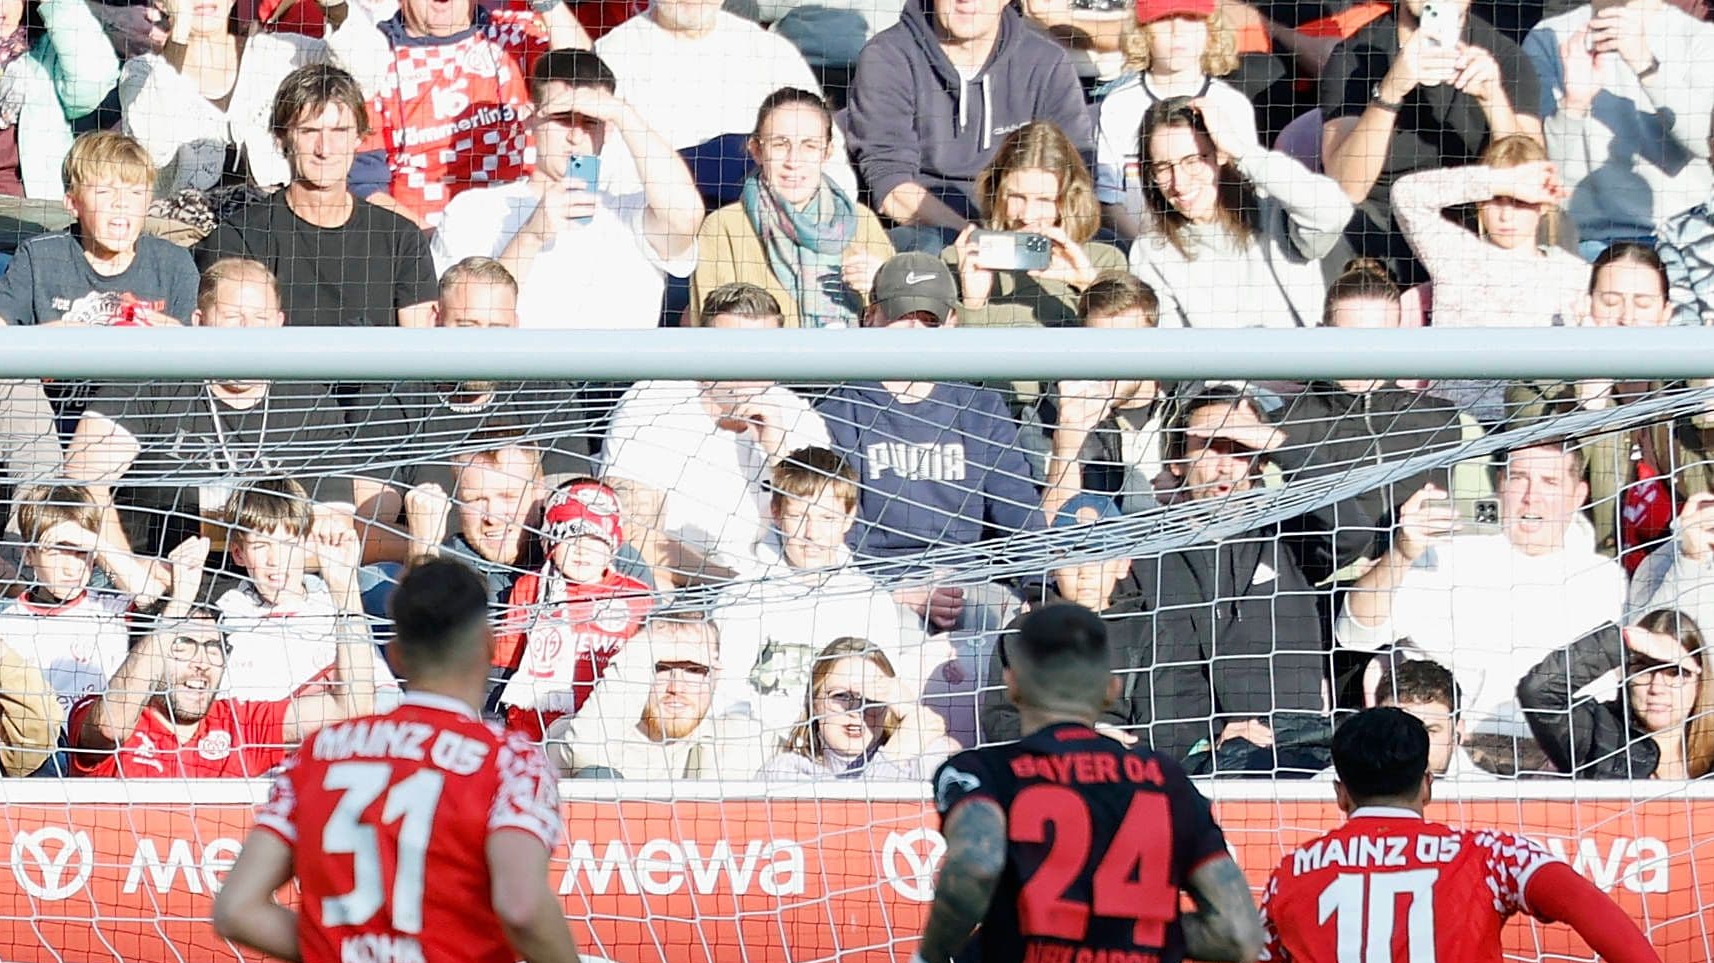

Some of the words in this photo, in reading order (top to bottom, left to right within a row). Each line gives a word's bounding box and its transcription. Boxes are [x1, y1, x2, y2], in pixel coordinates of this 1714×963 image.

[867, 442, 965, 480] PUMA
[313, 719, 433, 761] MAINZ
[431, 728, 490, 777] 05
[1009, 752, 1120, 787] BAYER
[1123, 753, 1166, 787] 04
[320, 762, 446, 934] 31
[1008, 784, 1180, 949] 24
[1293, 836, 1413, 877] MAINZ
[1415, 833, 1463, 864] 05
